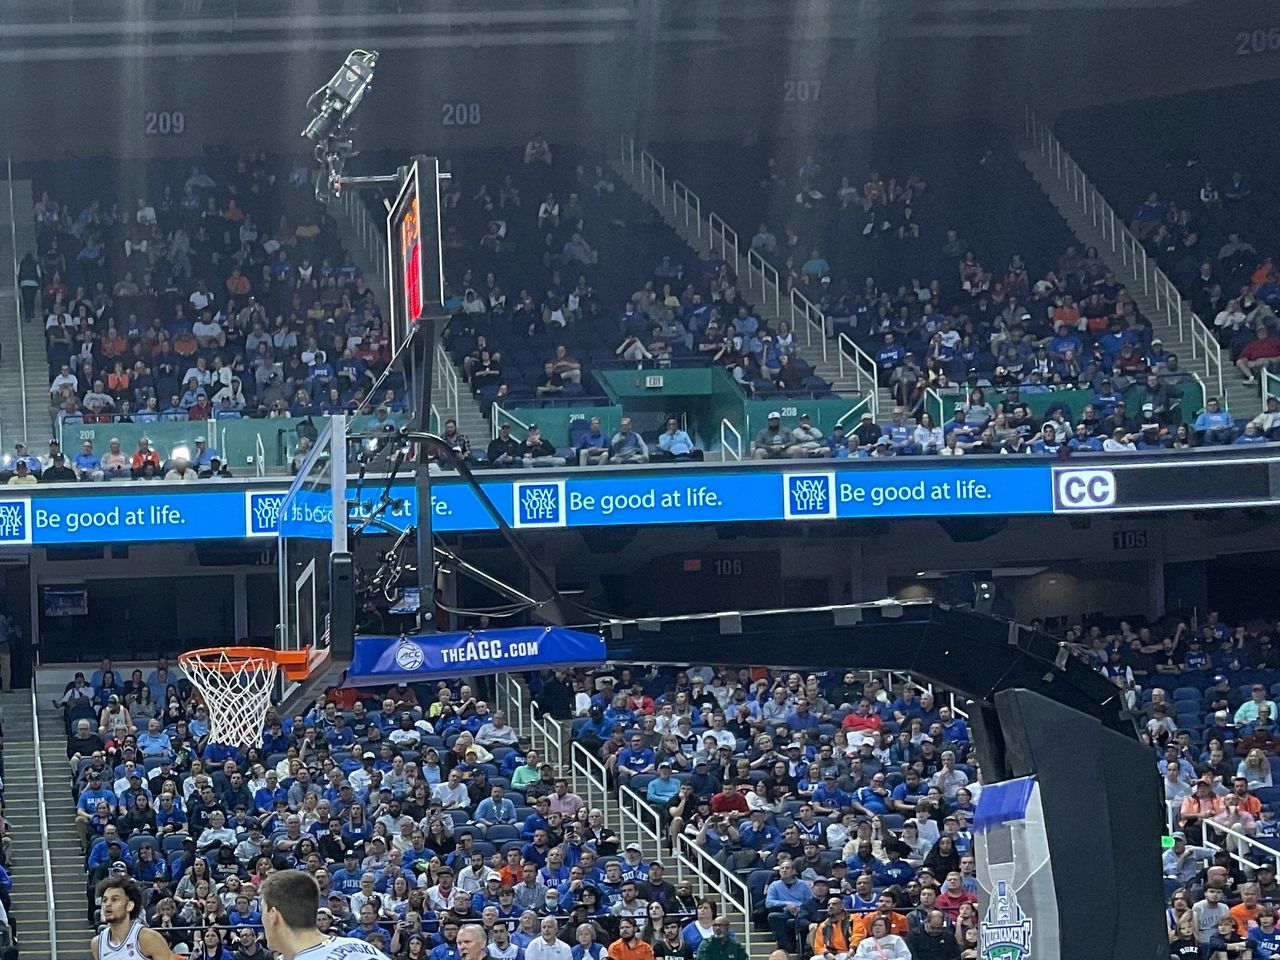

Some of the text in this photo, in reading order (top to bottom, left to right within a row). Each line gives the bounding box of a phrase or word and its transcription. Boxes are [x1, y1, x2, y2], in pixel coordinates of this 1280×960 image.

[783, 80, 822, 102] 207
[442, 103, 482, 126] 208
[145, 111, 185, 135] 209
[79, 430, 96, 440] 209
[525, 488, 554, 499] NEW
[795, 480, 824, 491] NEW
[841, 479, 992, 506] Be good at life.
[1064, 475, 1110, 504] CC
[521, 497, 556, 509] YORK
[571, 486, 722, 514] Be good at life.
[791, 489, 827, 501] YORK
[252, 507, 280, 519] YOR
[796, 500, 823, 511] LIFE
[37, 505, 185, 532] Be good at life.
[526, 508, 553, 520] LIFE
[258, 517, 277, 529] LIF
[1116, 531, 1147, 548] 105
[714, 560, 742, 576] 106
[400, 640, 539, 663] ACC THEACC.COM
[982, 920, 1031, 956] TOURNAMENT
